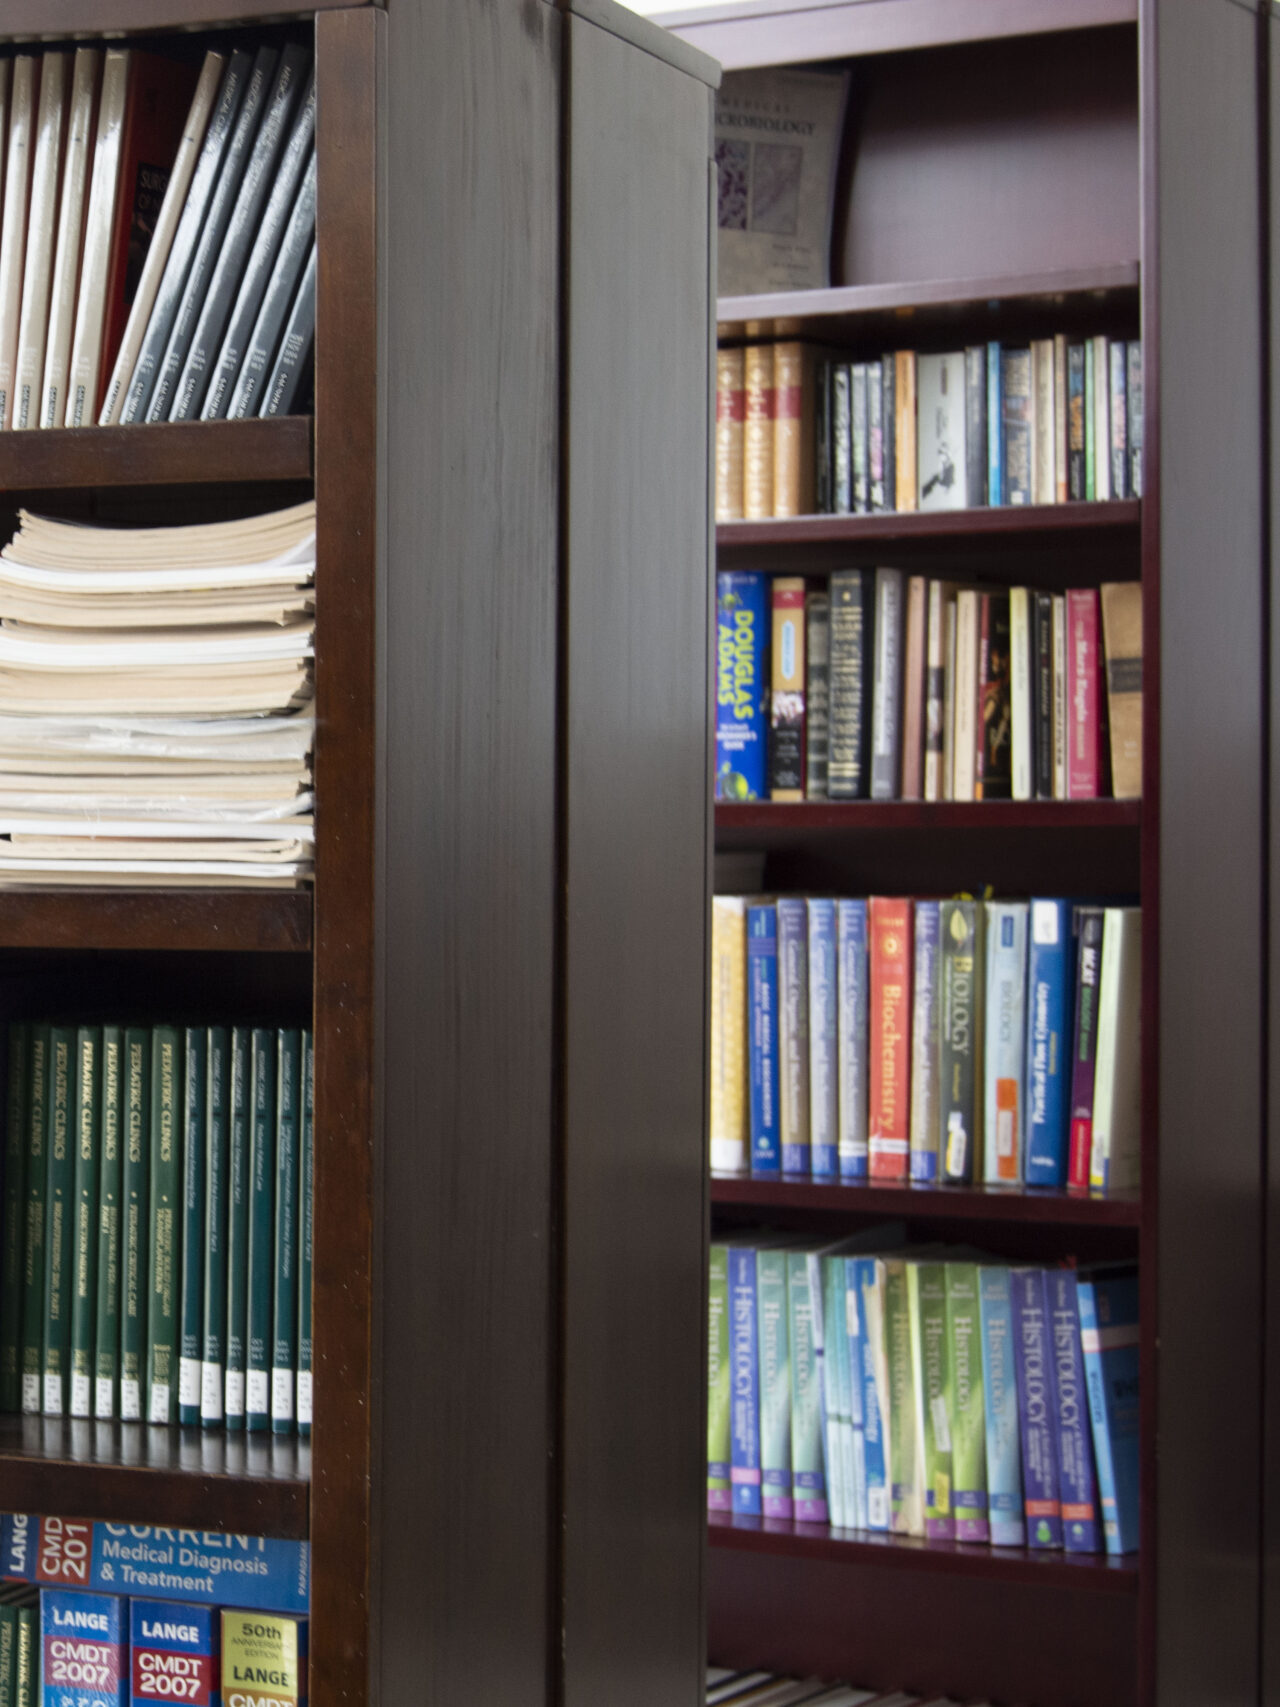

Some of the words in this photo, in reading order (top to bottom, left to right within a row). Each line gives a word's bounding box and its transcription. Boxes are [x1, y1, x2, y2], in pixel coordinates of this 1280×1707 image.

[715, 111, 816, 136] ICROBIOLOGY
[718, 624, 736, 706] ADAMS
[734, 610, 754, 720] DOUGLAS
[951, 956, 973, 1056] BIOLOGY
[55, 1042, 67, 1109] PEDIATRIC
[82, 1041, 93, 1108] PEDIATRIC
[106, 1042, 118, 1109] PEDIATRIC
[130, 1043, 142, 1111] PEDIATRIC
[162, 1043, 172, 1110] PEDIATRIC
[881, 984, 902, 1131] Biochemistry
[54, 1109, 66, 1160] CLINICS
[81, 1108, 92, 1160] CLINICS
[105, 1109, 117, 1160] CLINICS
[129, 1111, 141, 1163] CLINICS
[161, 1110, 172, 1162] CLINICS
[734, 1285, 753, 1397] HISTOLOGY
[1021, 1308, 1048, 1427] HISTOLOGY
[1053, 1310, 1079, 1428] HISTOLOGY
[9, 1513, 28, 1573] LANG
[41, 1516, 64, 1576] CMD
[62, 1523, 89, 1580] 201
[103, 1539, 171, 1565] Medical
[179, 1547, 269, 1576] Diagnosis
[100, 1563, 115, 1581] &
[122, 1565, 214, 1594] Treatment
[53, 1607, 108, 1632] LANGE
[141, 1620, 199, 1644] LANGE
[241, 1623, 282, 1639] 50th
[50, 1640, 111, 1664] CMDT
[51, 1661, 110, 1686] 2007
[138, 1653, 202, 1678] CMDT
[233, 1665, 289, 1688] LANGE
[139, 1673, 201, 1699] 2007
